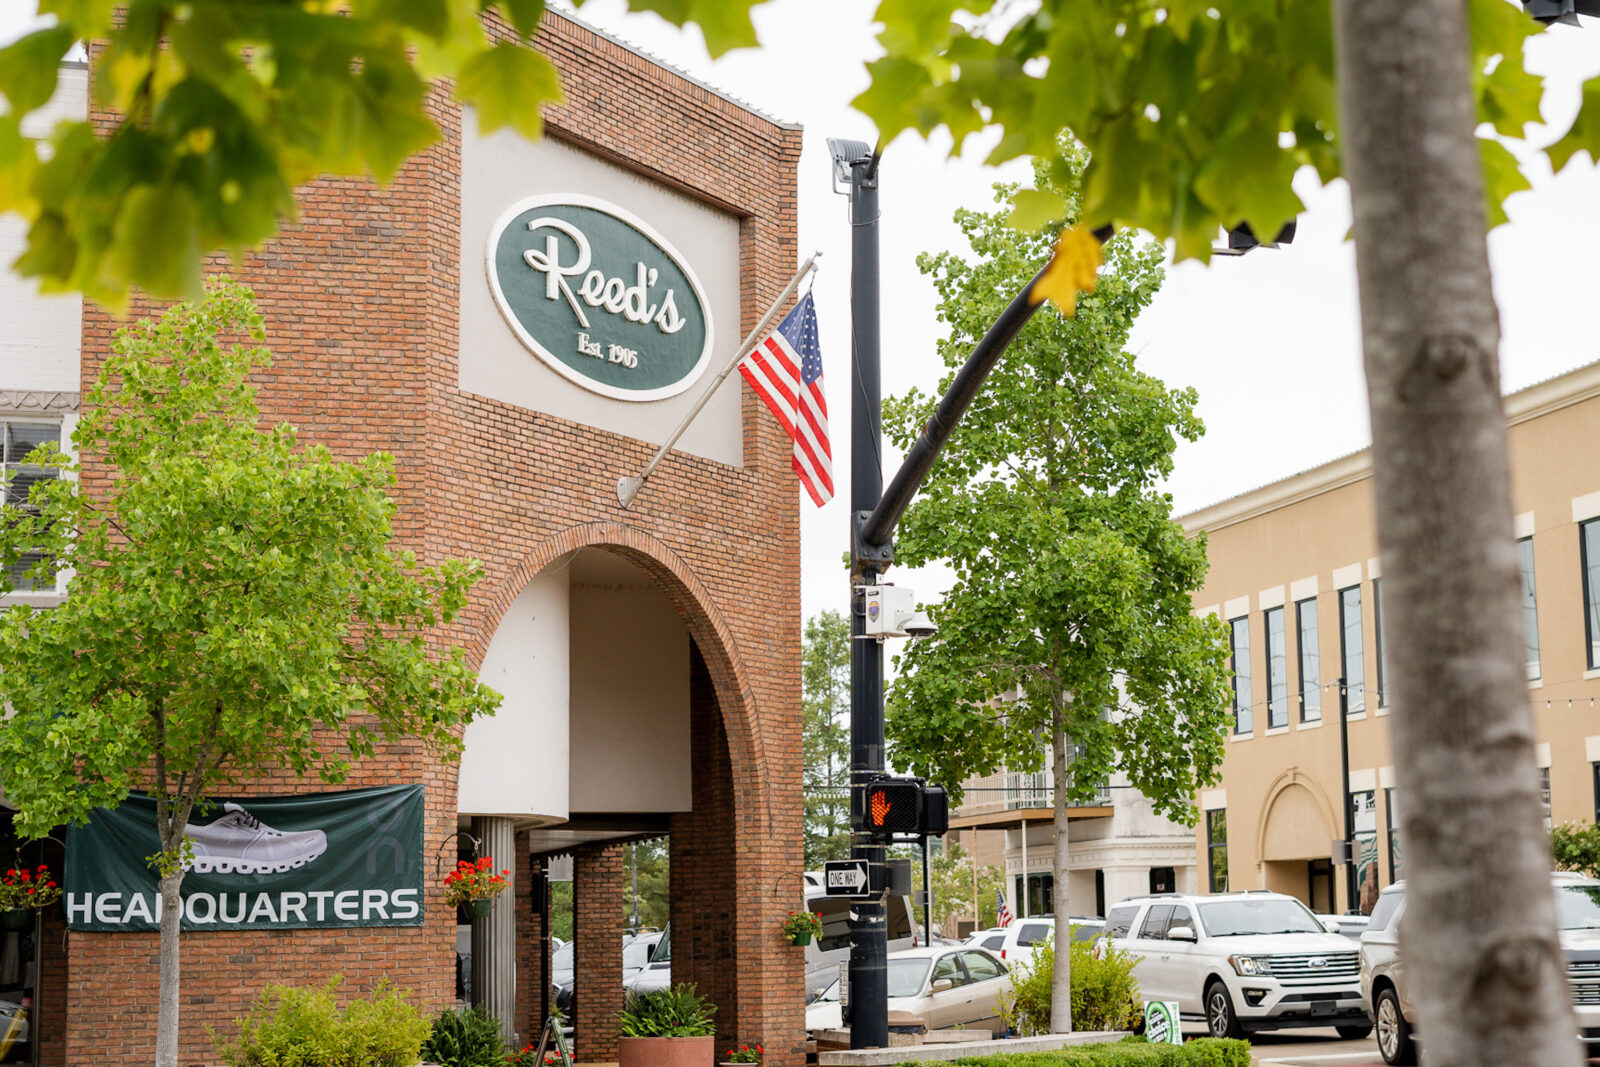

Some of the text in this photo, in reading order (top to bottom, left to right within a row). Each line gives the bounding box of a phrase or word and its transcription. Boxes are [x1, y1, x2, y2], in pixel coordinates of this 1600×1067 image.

[523, 217, 687, 334] Reed's
[577, 332, 638, 369] Est. 1905
[830, 871, 857, 886] ONE WAY
